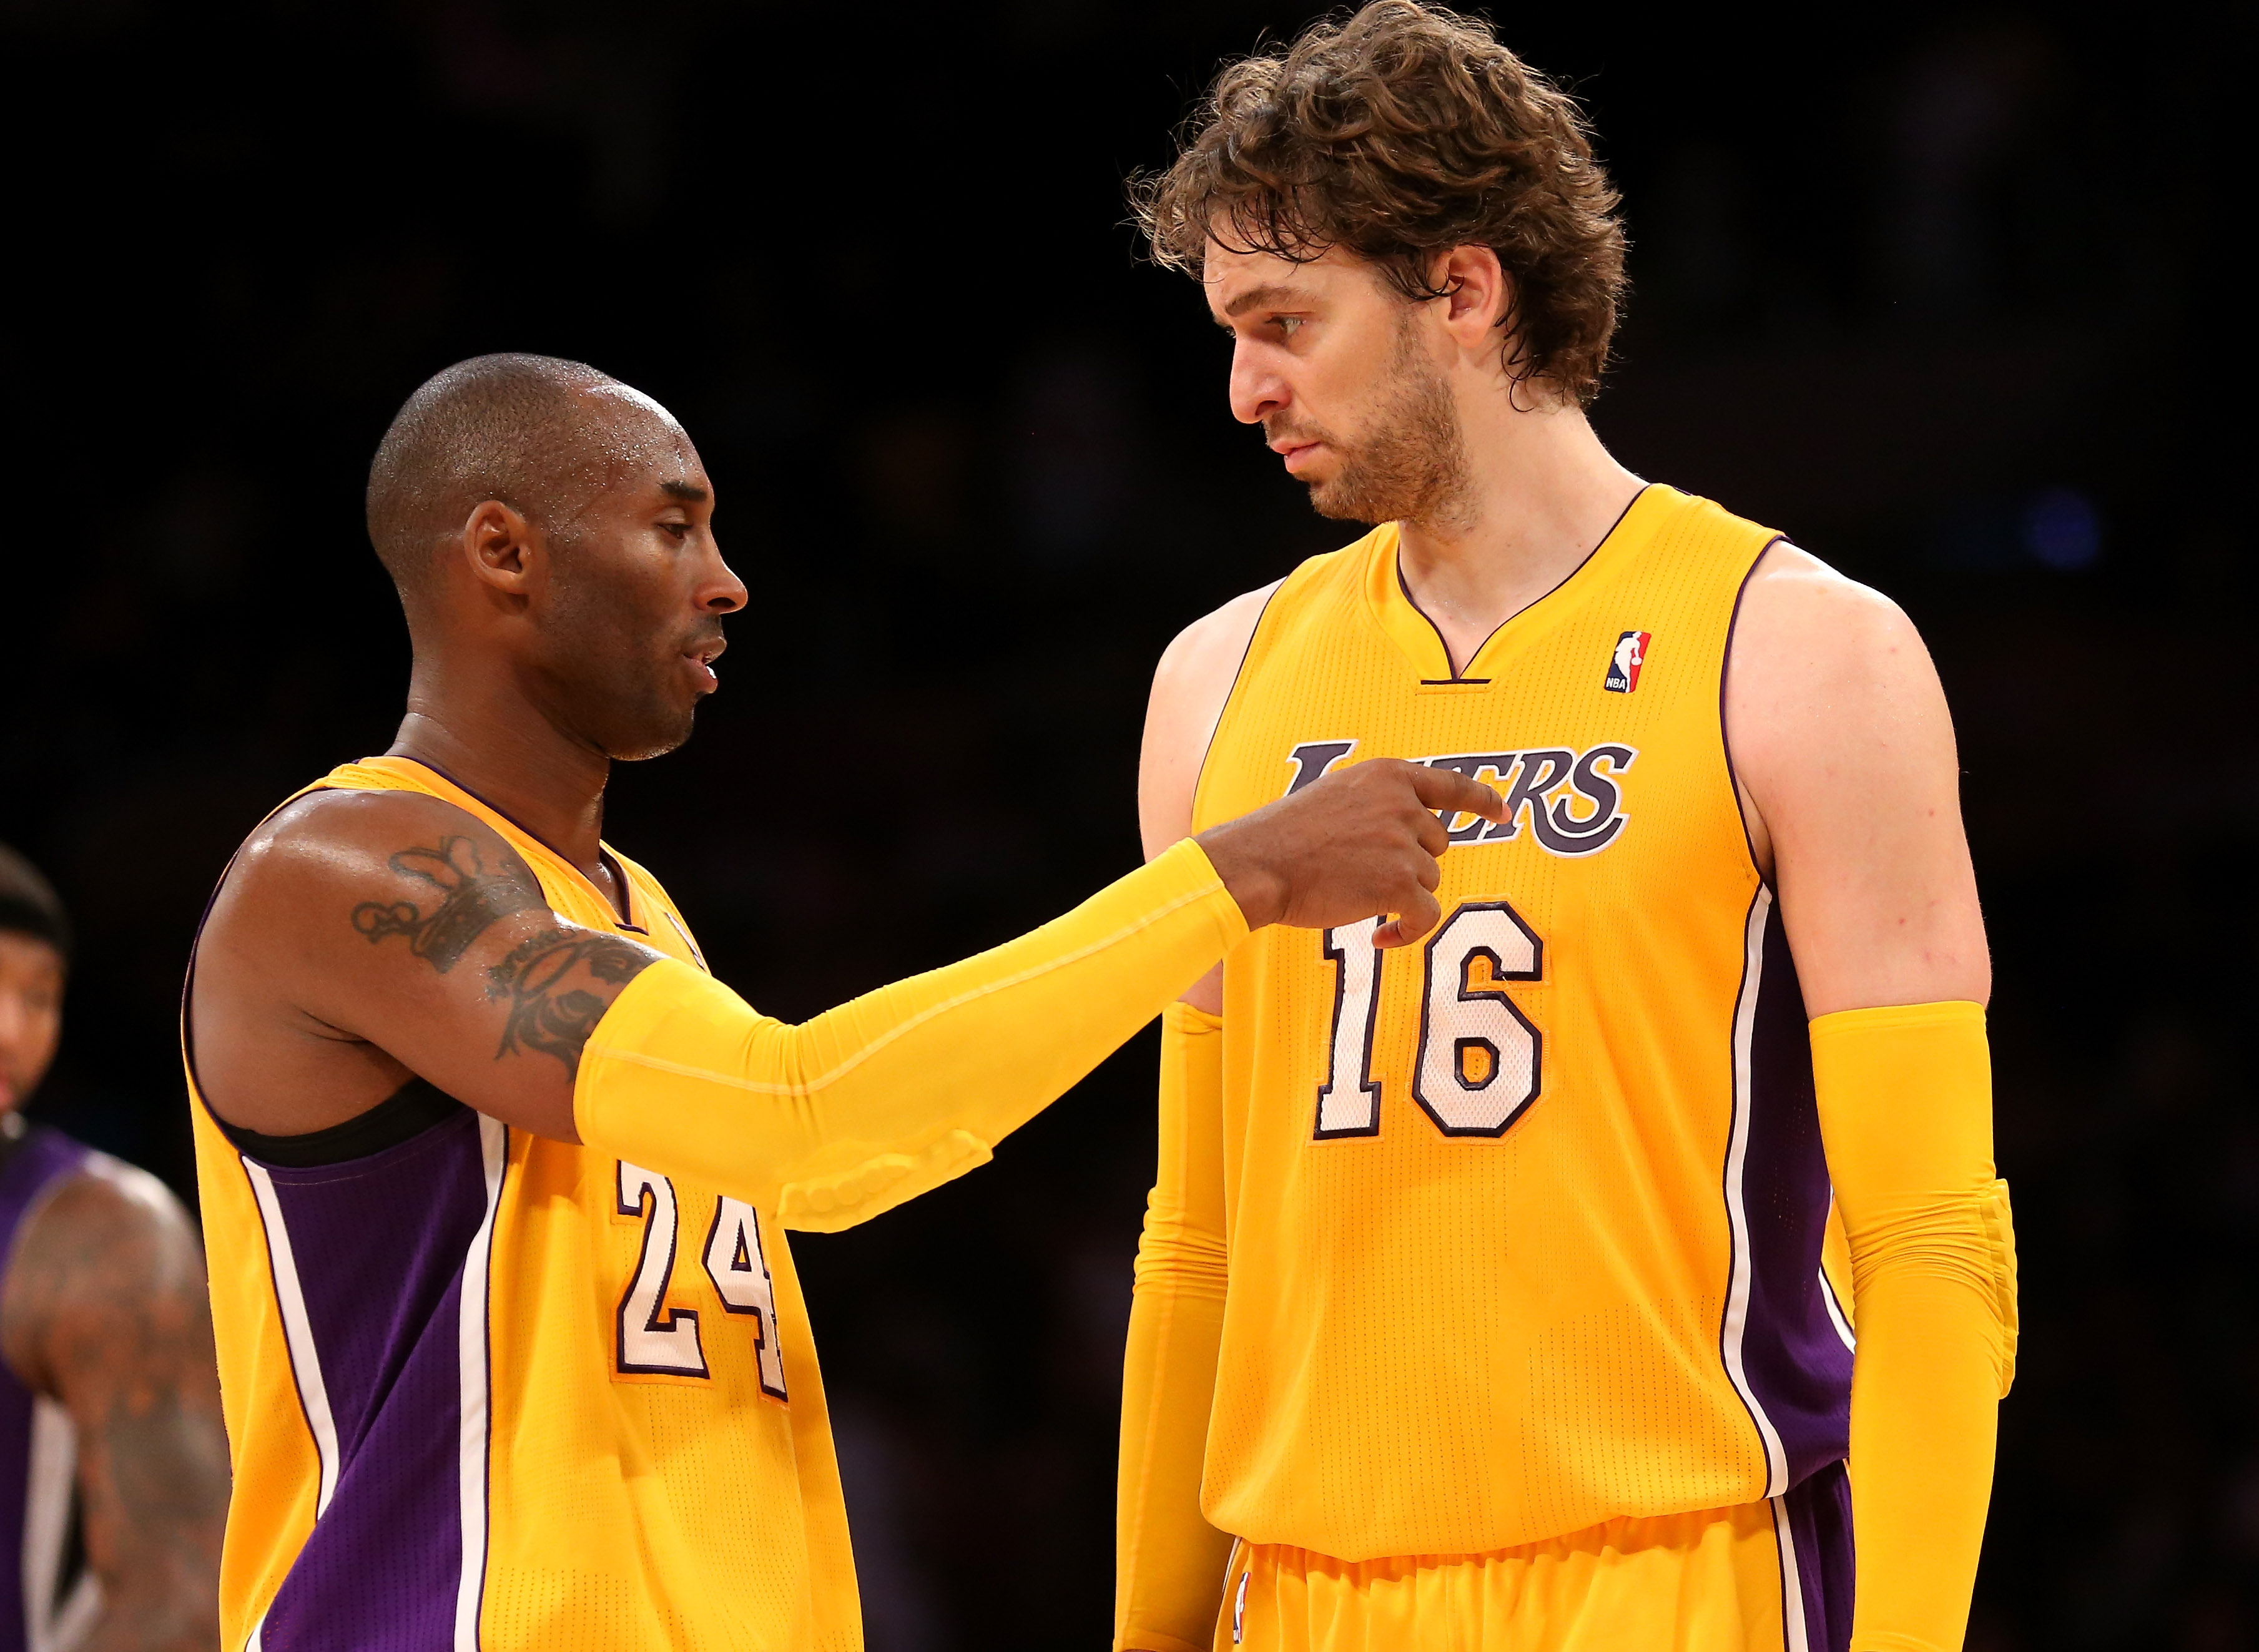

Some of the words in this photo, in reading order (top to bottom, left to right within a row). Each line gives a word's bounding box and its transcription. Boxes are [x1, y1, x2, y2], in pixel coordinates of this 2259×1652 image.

[1605, 677, 1626, 690] NBA
[1286, 739, 1640, 858] ERS
[1313, 901, 1543, 1140] 16
[617, 1159, 789, 1403] 24
